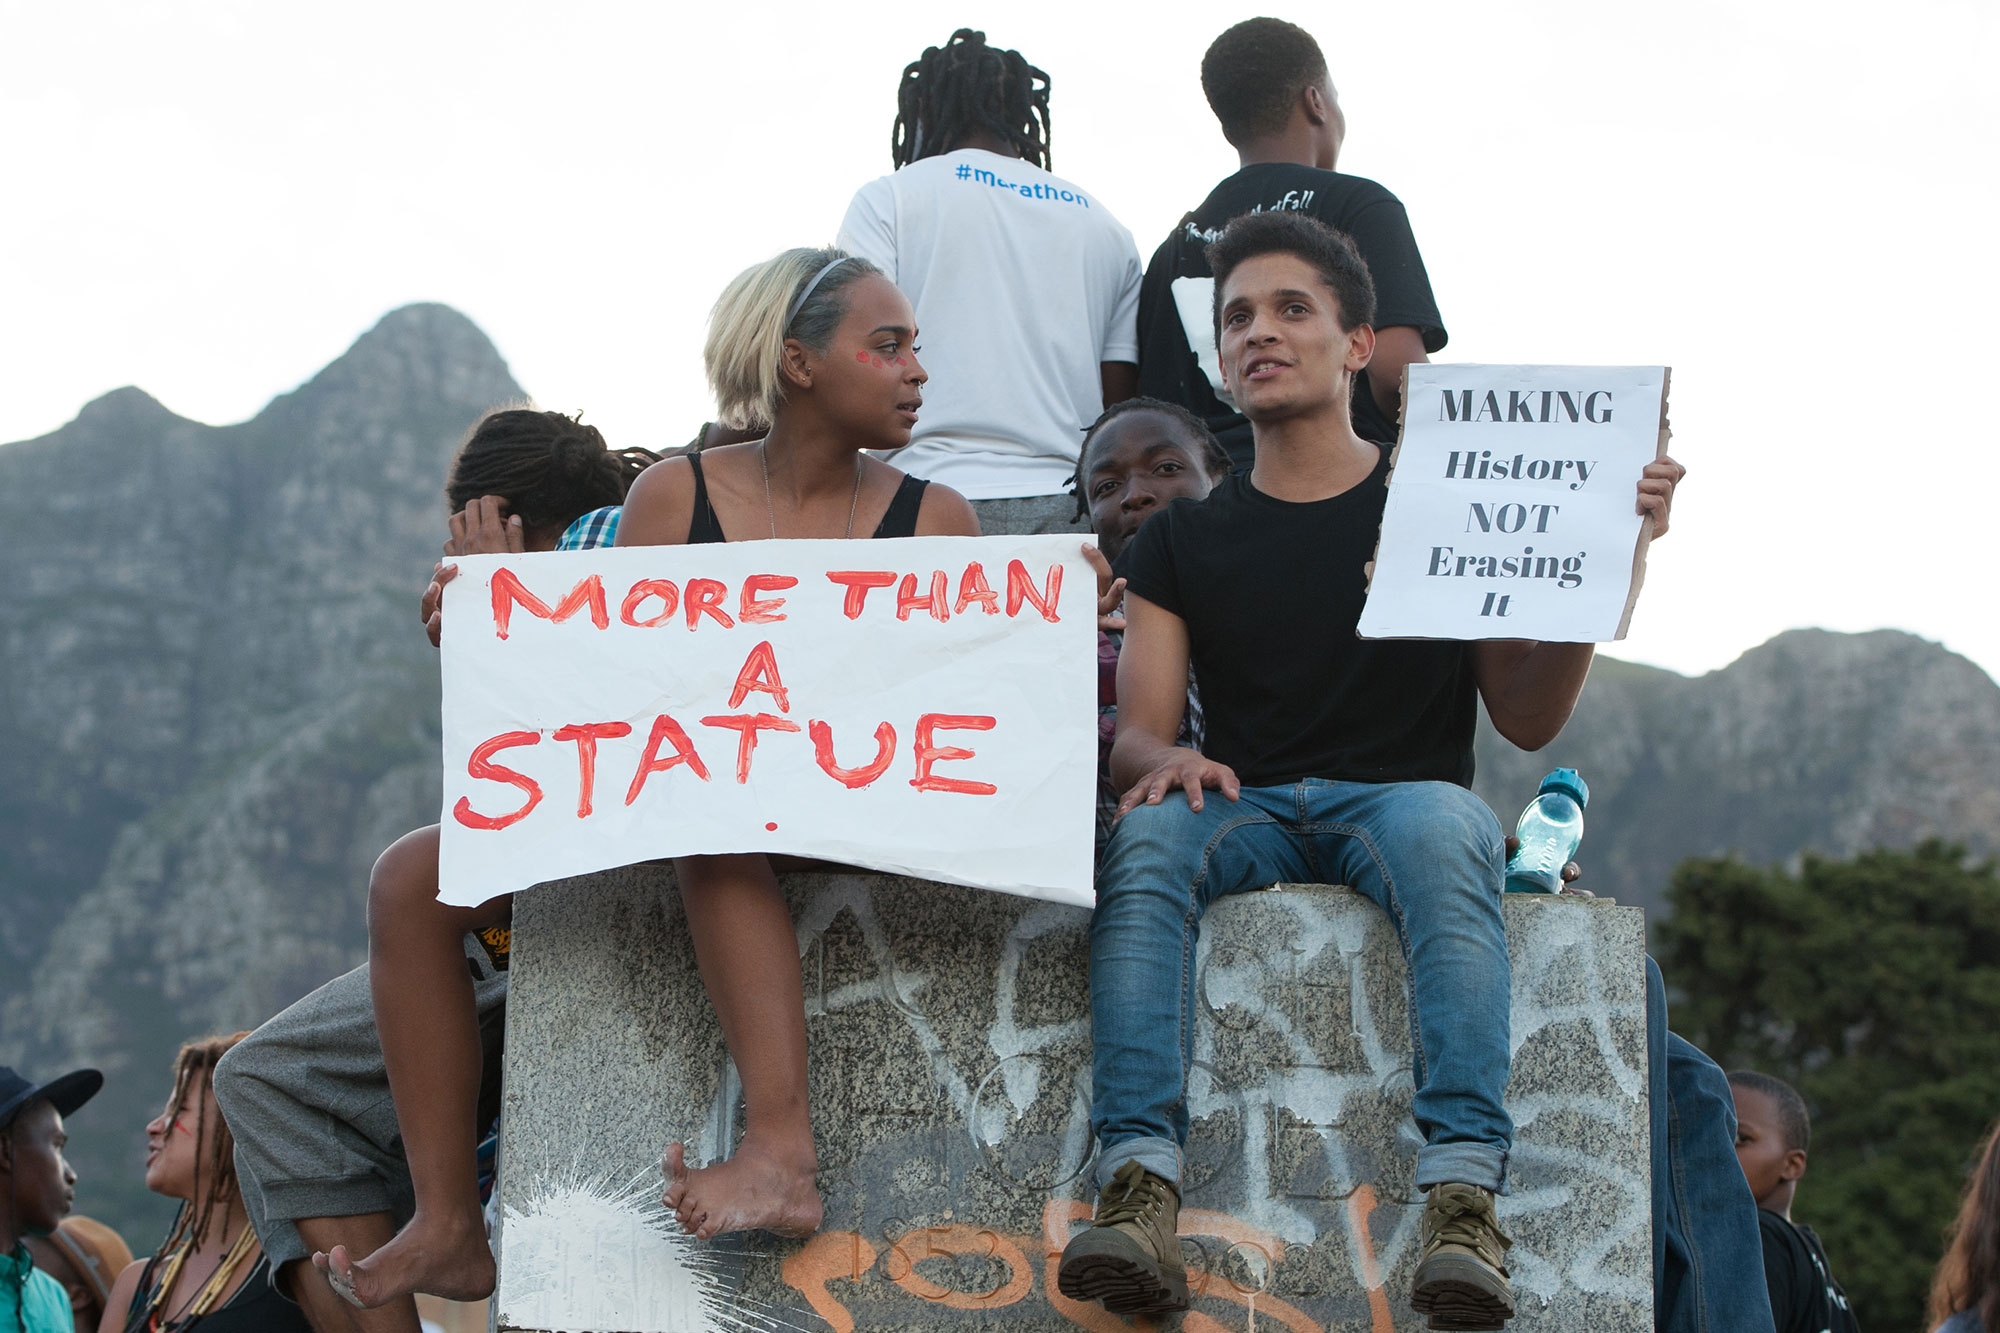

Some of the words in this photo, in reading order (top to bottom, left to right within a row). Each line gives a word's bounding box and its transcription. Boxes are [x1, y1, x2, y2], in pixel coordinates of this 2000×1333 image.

[1438, 389, 1613, 424] MAKING
[1443, 450, 1598, 491] History
[1464, 503, 1560, 534] NOT
[1425, 546, 1587, 589] Erasing
[490, 567, 799, 640] MORE
[825, 559, 1064, 623] THAN
[1477, 592, 1514, 618] It
[727, 640, 791, 713] A
